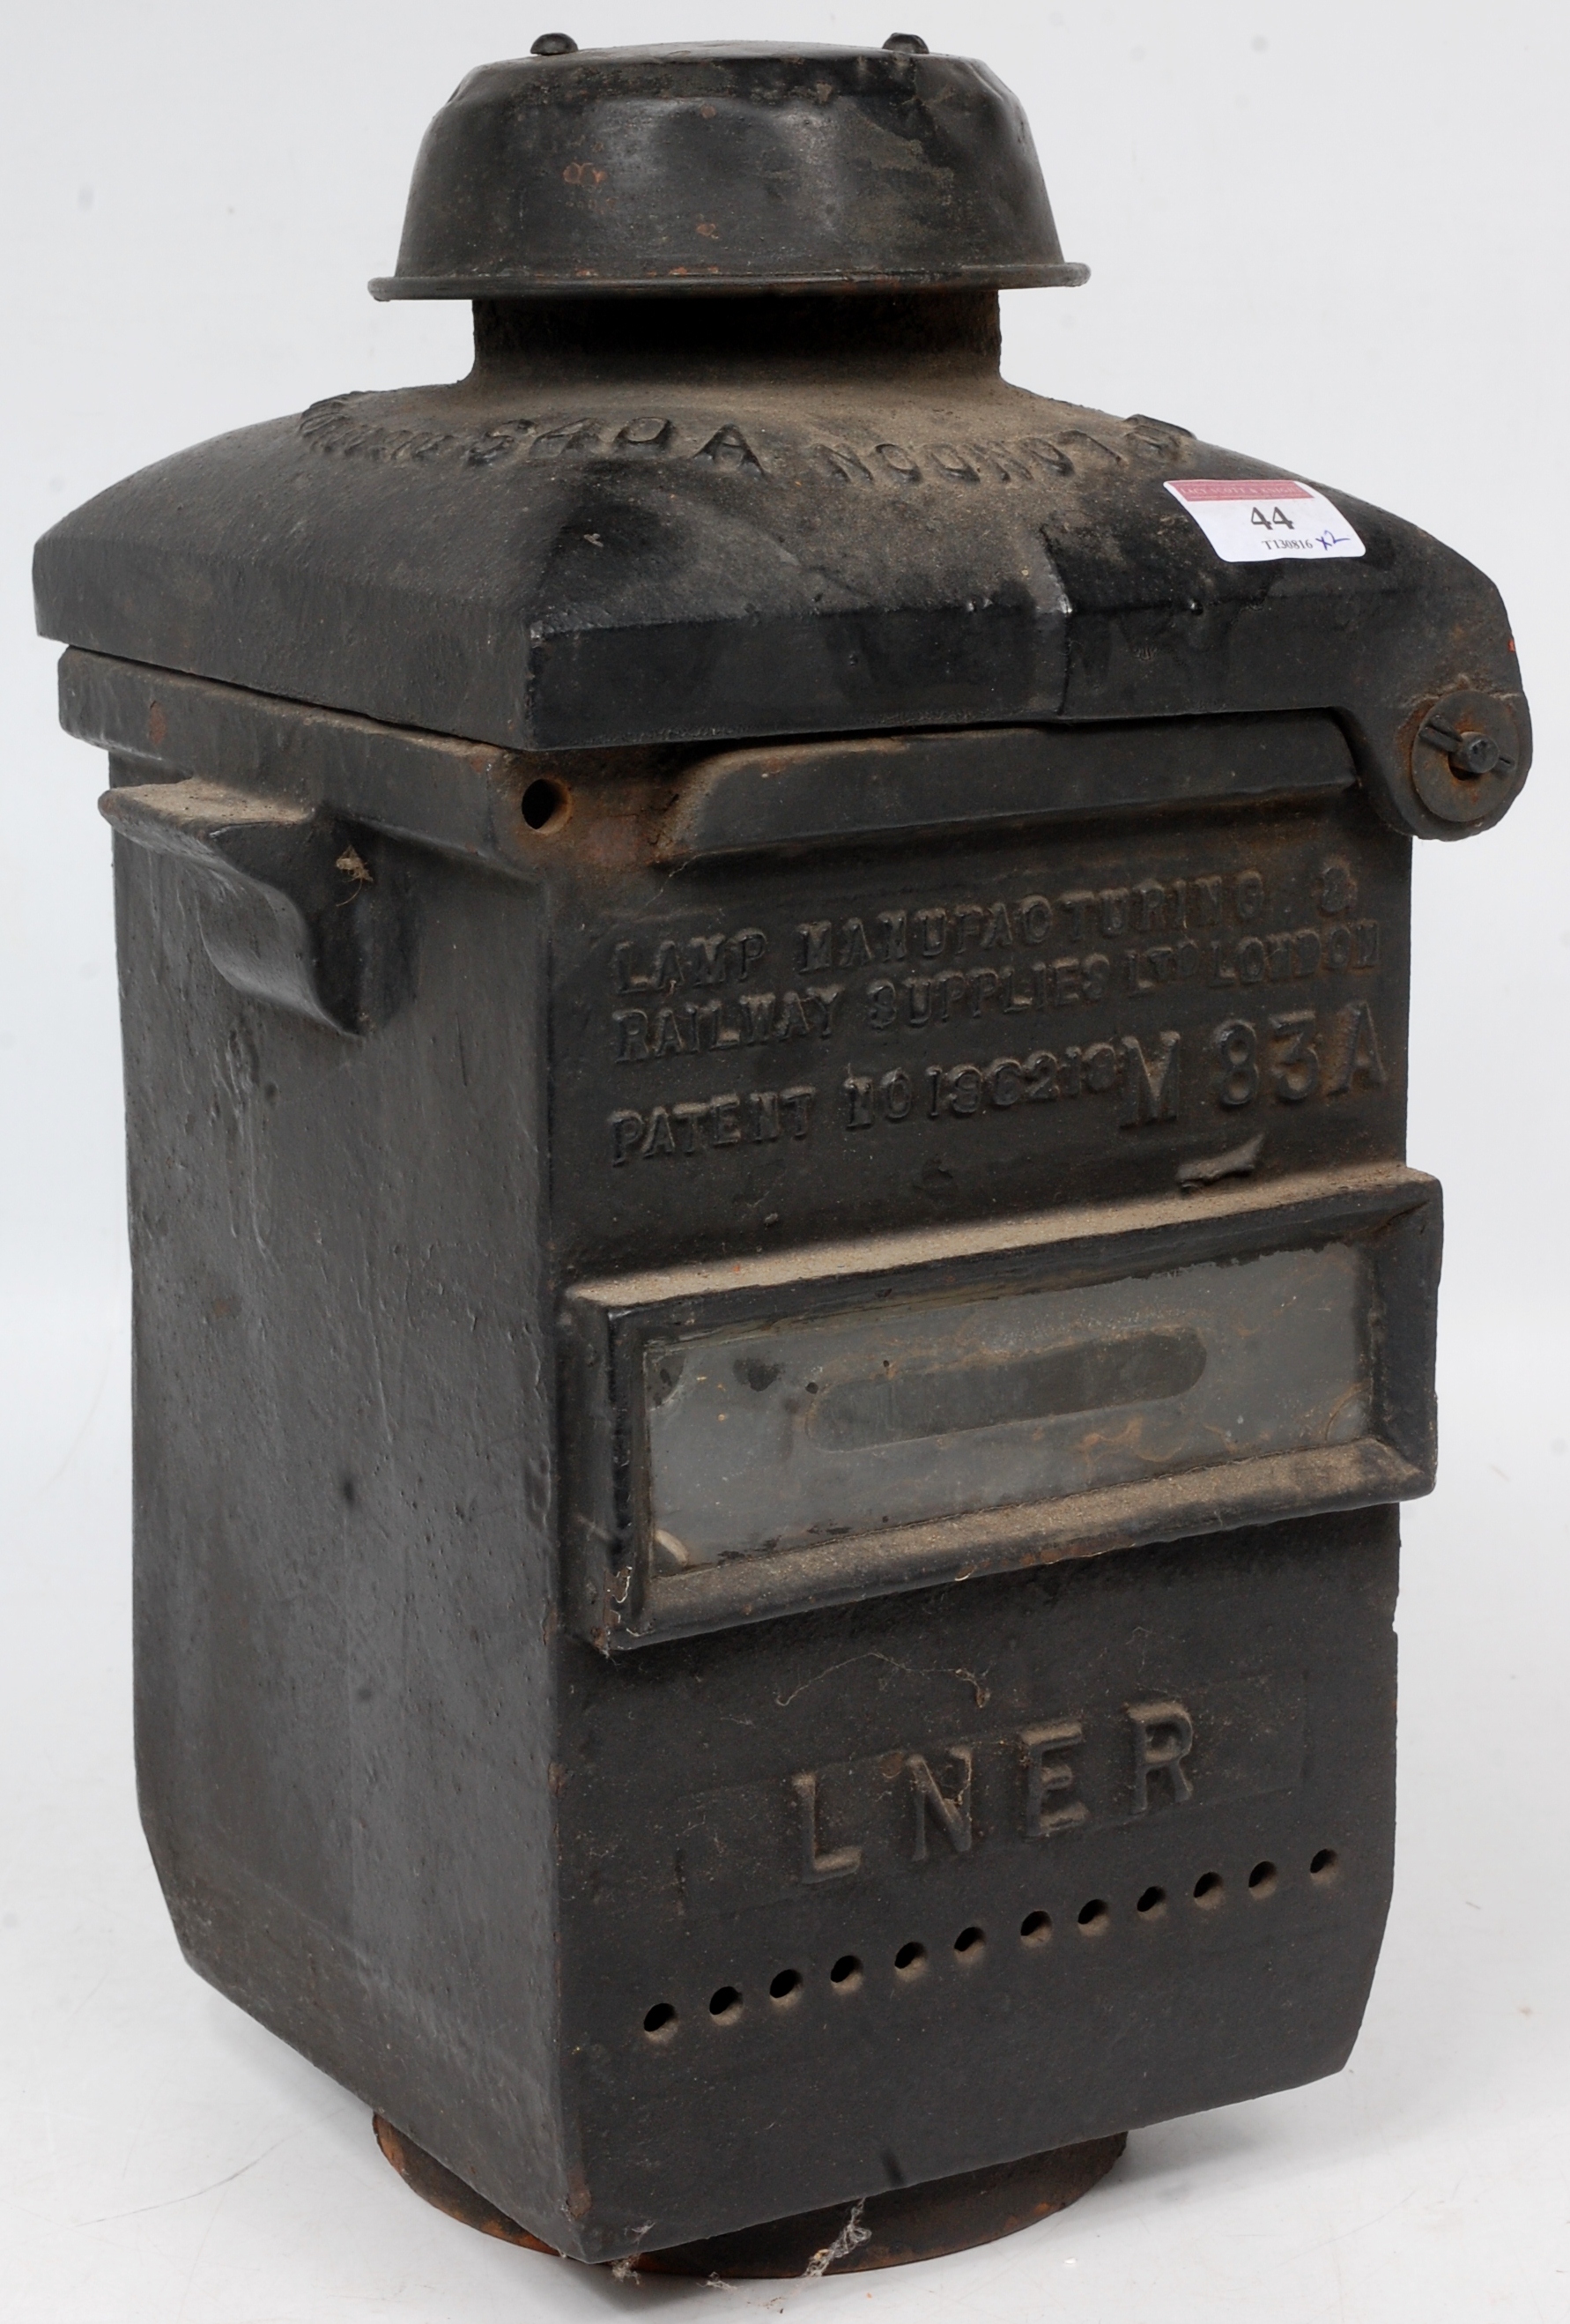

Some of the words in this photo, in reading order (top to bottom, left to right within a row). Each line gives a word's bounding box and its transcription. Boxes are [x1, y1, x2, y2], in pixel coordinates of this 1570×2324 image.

[1250, 506, 1295, 531] 44
[1261, 538, 1314, 551] T130816
[612, 926, 768, 996] LAMP
[796, 868, 1265, 975] MANUFACTURING
[611, 984, 846, 1065] RAILWAY
[865, 952, 1111, 1033] SUPPLIES
[1208, 917, 1381, 988] LONDON
[607, 1085, 818, 1167] PATENT
